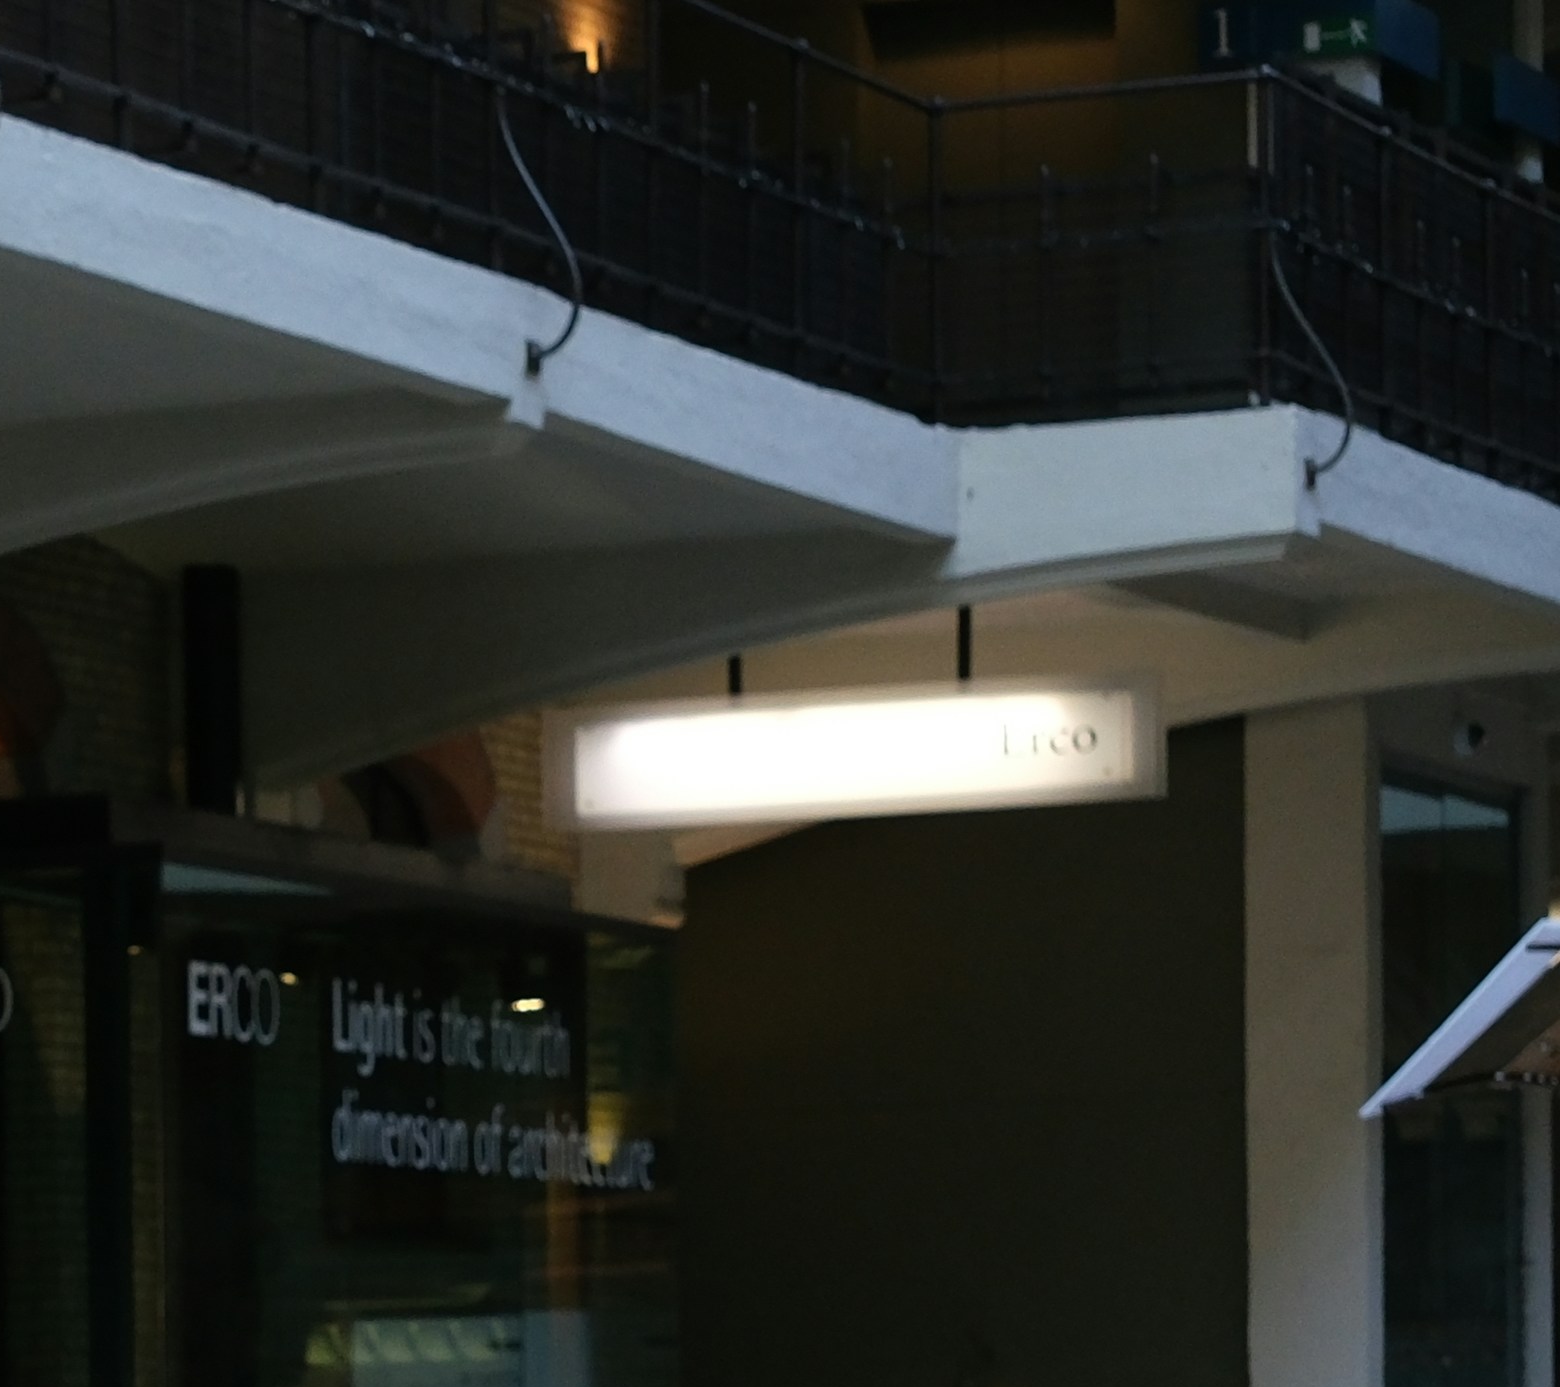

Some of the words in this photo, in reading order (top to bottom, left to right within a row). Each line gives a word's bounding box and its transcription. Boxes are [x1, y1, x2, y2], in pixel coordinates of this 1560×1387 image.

[186, 959, 280, 1046] ERCO
[332, 977, 408, 1078] Light
[412, 987, 437, 1063] is
[441, 995, 484, 1071] the
[491, 999, 570, 1079] fourth
[331, 1087, 468, 1173] dimension
[474, 1102, 504, 1177] of
